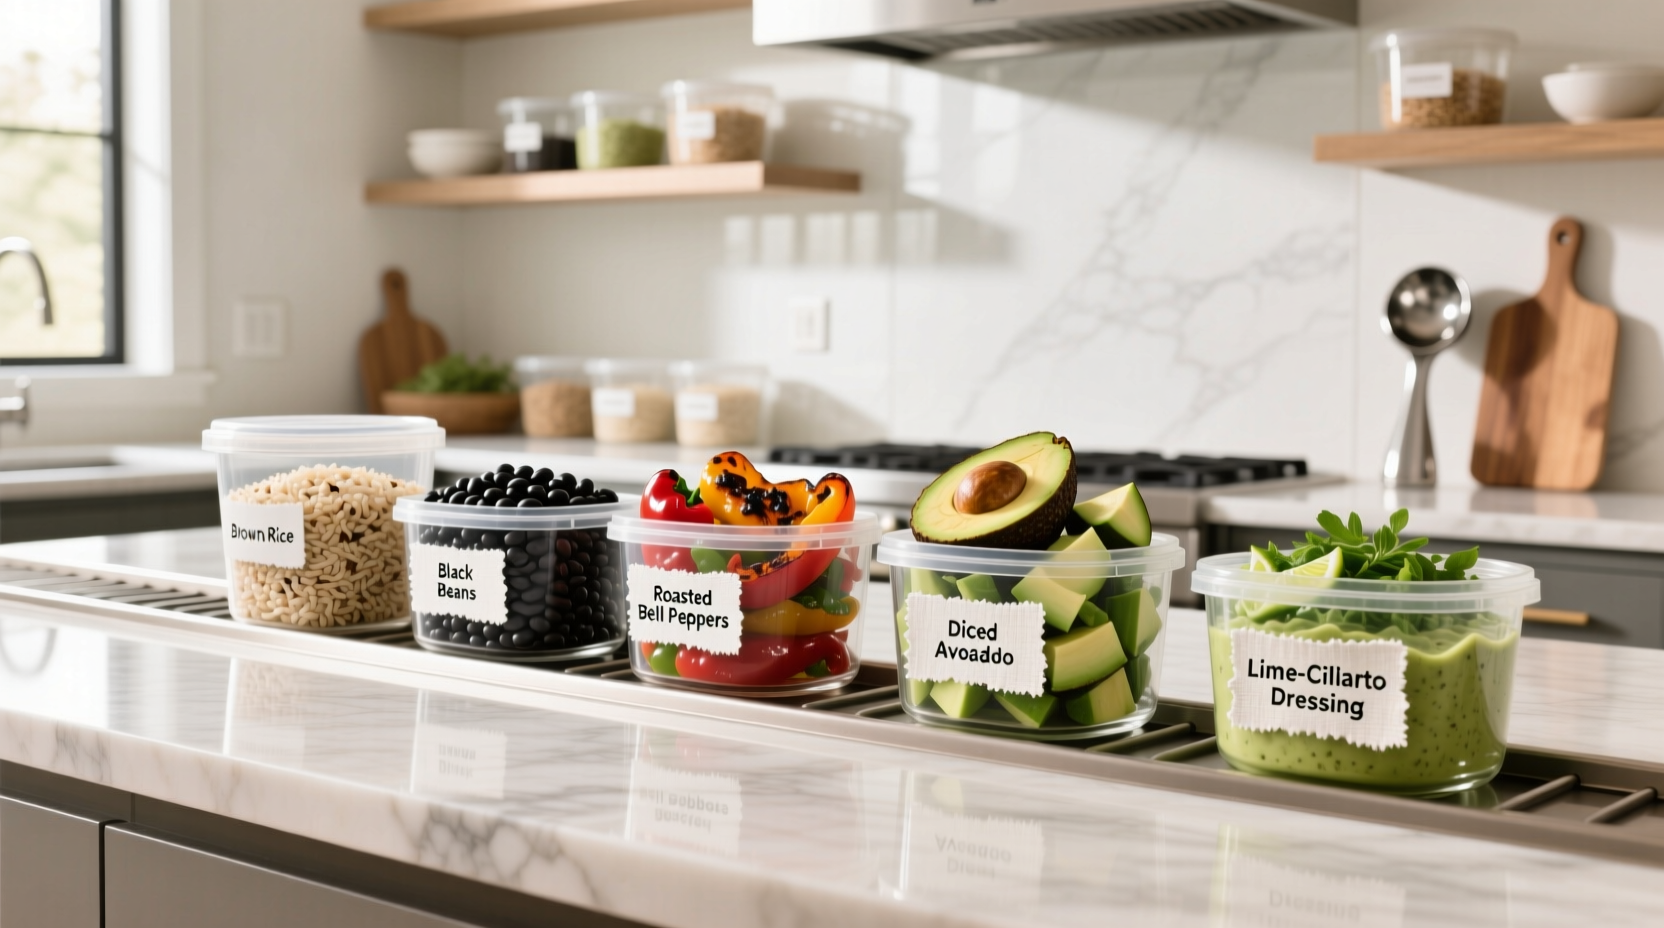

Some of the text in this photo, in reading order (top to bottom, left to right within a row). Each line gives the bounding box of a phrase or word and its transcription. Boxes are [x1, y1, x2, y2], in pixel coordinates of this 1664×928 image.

[268, 526, 294, 544] Rice
[438, 562, 474, 581] Black
[437, 582, 477, 601] Beans
[653, 585, 712, 606] Roasted
[638, 604, 729, 632] Bell Peppers
[948, 619, 998, 641] Diced
[1271, 686, 1365, 721] Dressing
